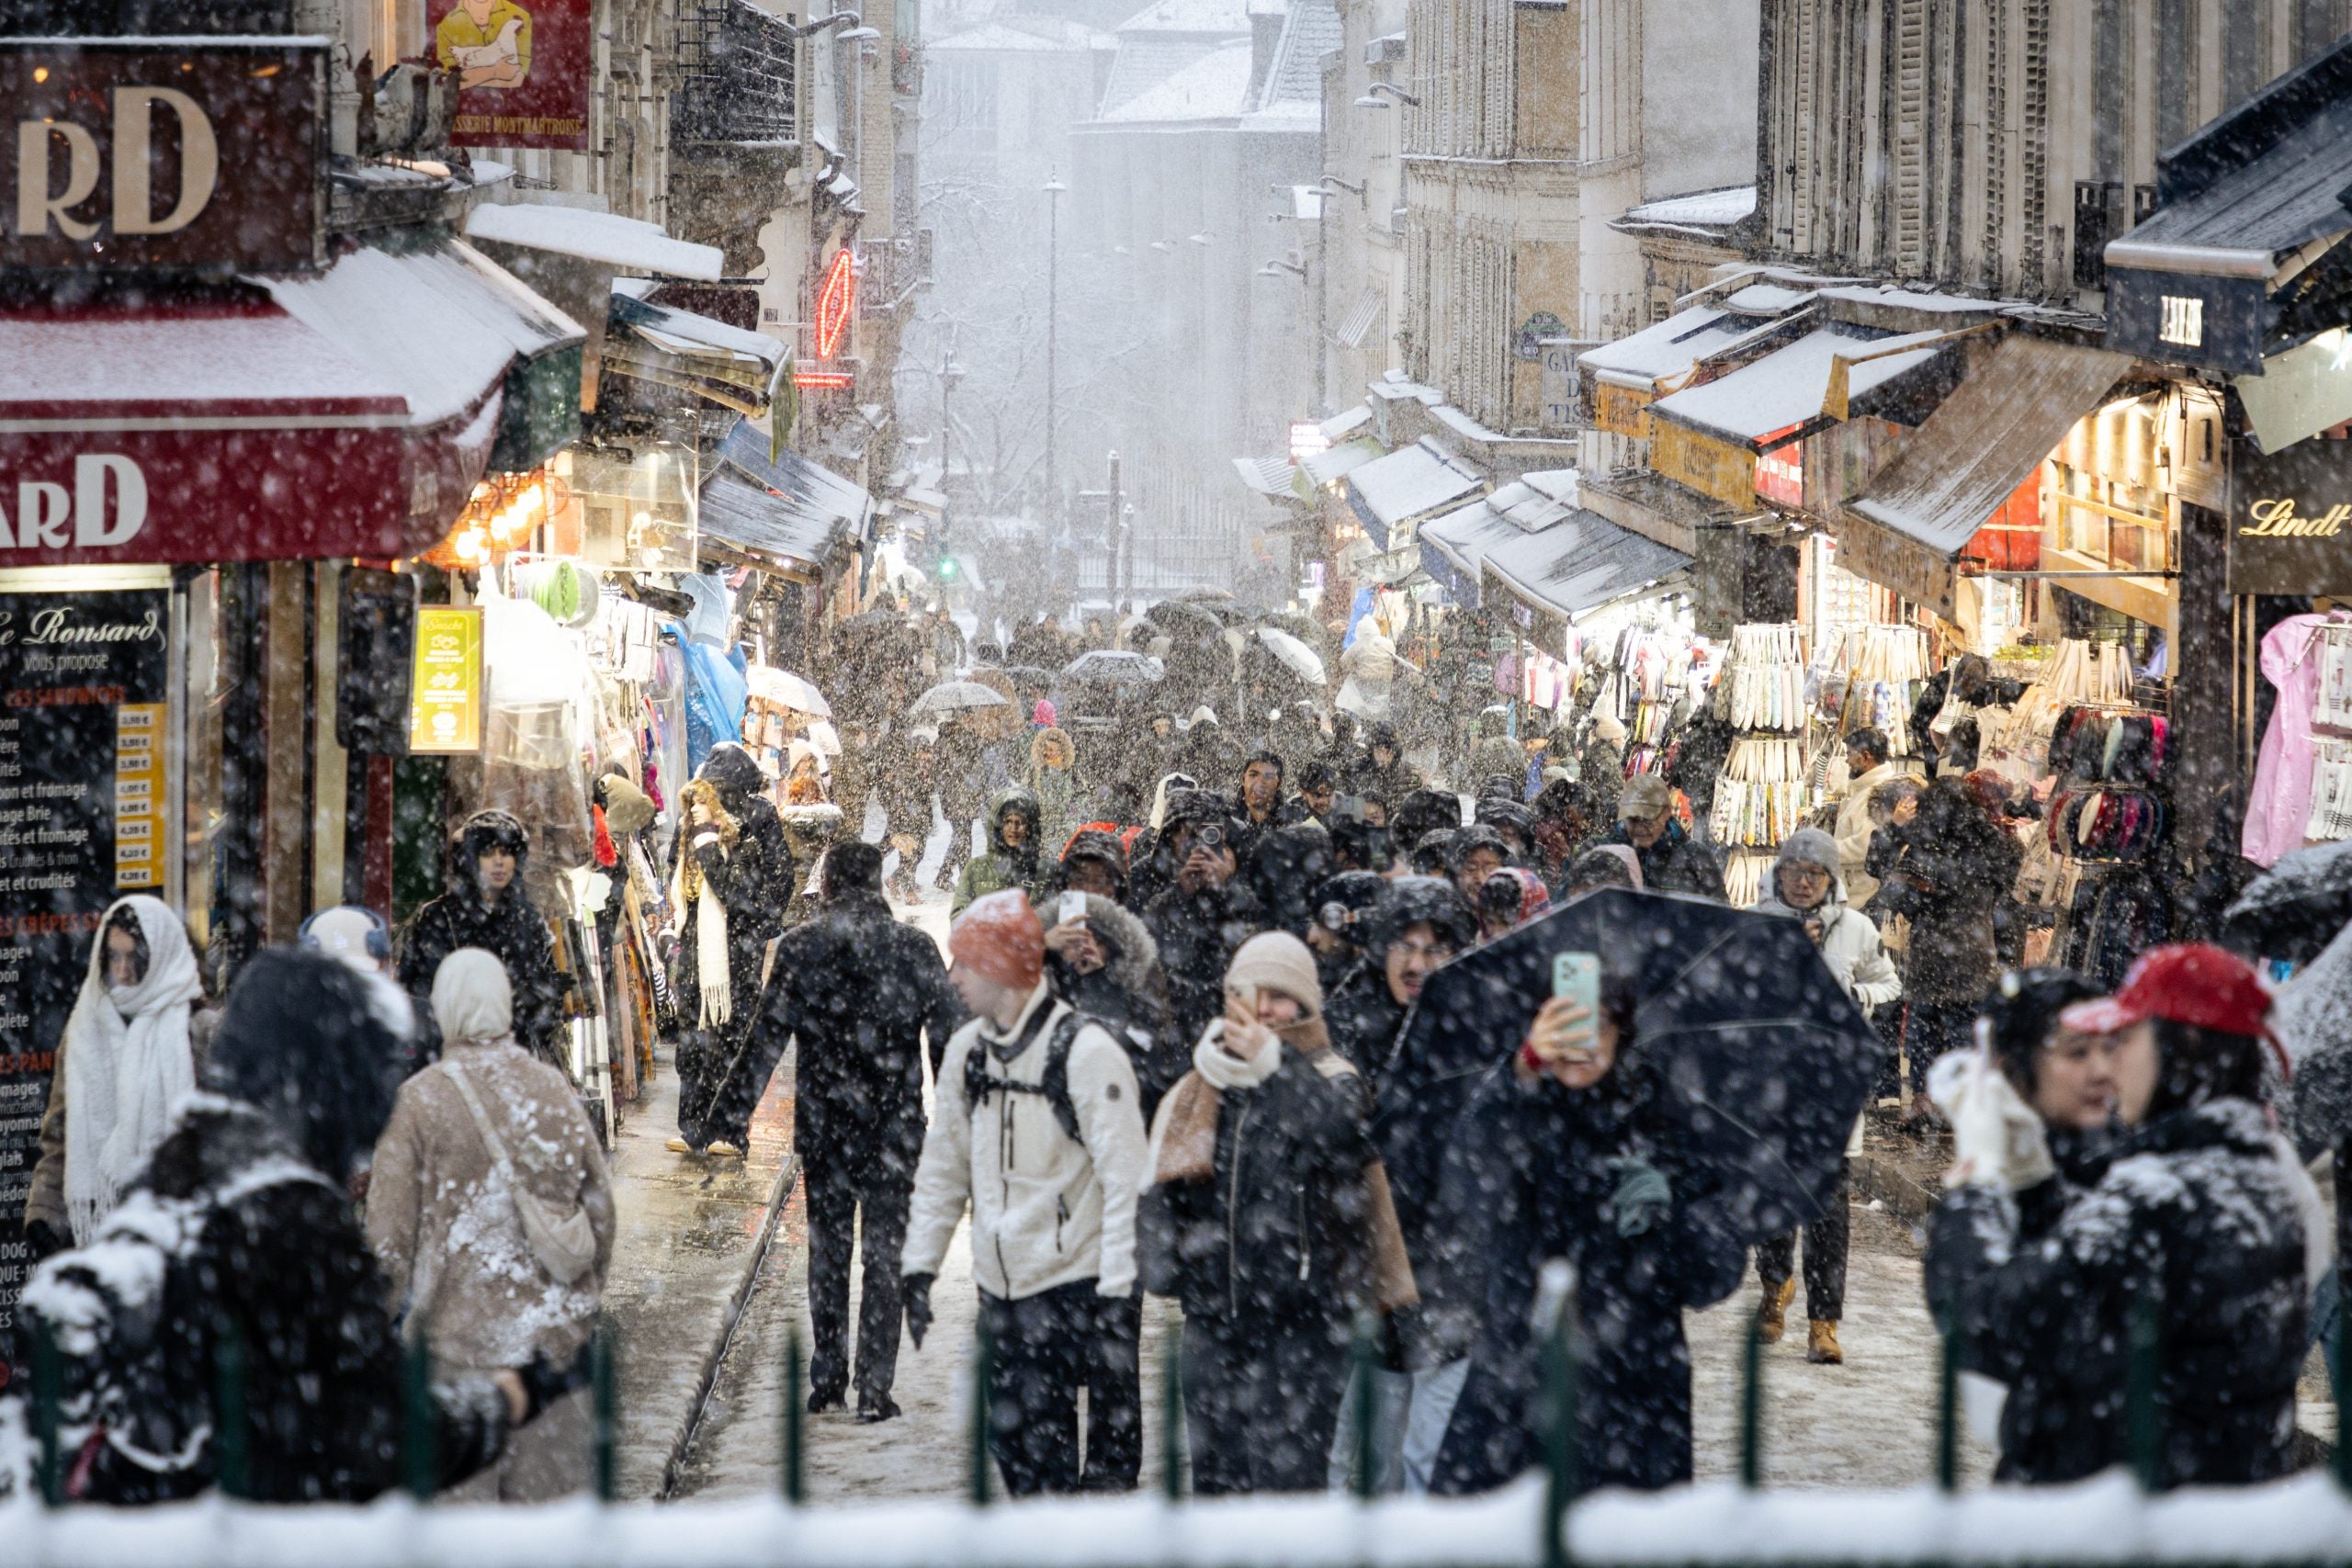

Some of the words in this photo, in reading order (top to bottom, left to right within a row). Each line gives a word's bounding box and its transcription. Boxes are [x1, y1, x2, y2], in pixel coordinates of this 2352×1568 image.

[453, 116, 491, 132] SSERIE
[493, 117, 582, 135] MONTMARTROISE
[0, 86, 218, 241] RD
[826, 278, 845, 330] TABAC
[2238, 498, 2352, 536] Lindt
[21, 605, 166, 652] Ronsard
[425, 618, 462, 632] Snacks
[57, 653, 109, 675] propose
[20, 784, 35, 798] et
[36, 782, 87, 801] fromage
[26, 804, 51, 822] Brie
[22, 829, 36, 844] et
[38, 827, 89, 845] fromage
[47, 852, 55, 866] &
[57, 851, 78, 865] thon
[12, 875, 26, 891] et
[28, 871, 75, 890] crudités
[0, 1083, 40, 1100] mages
